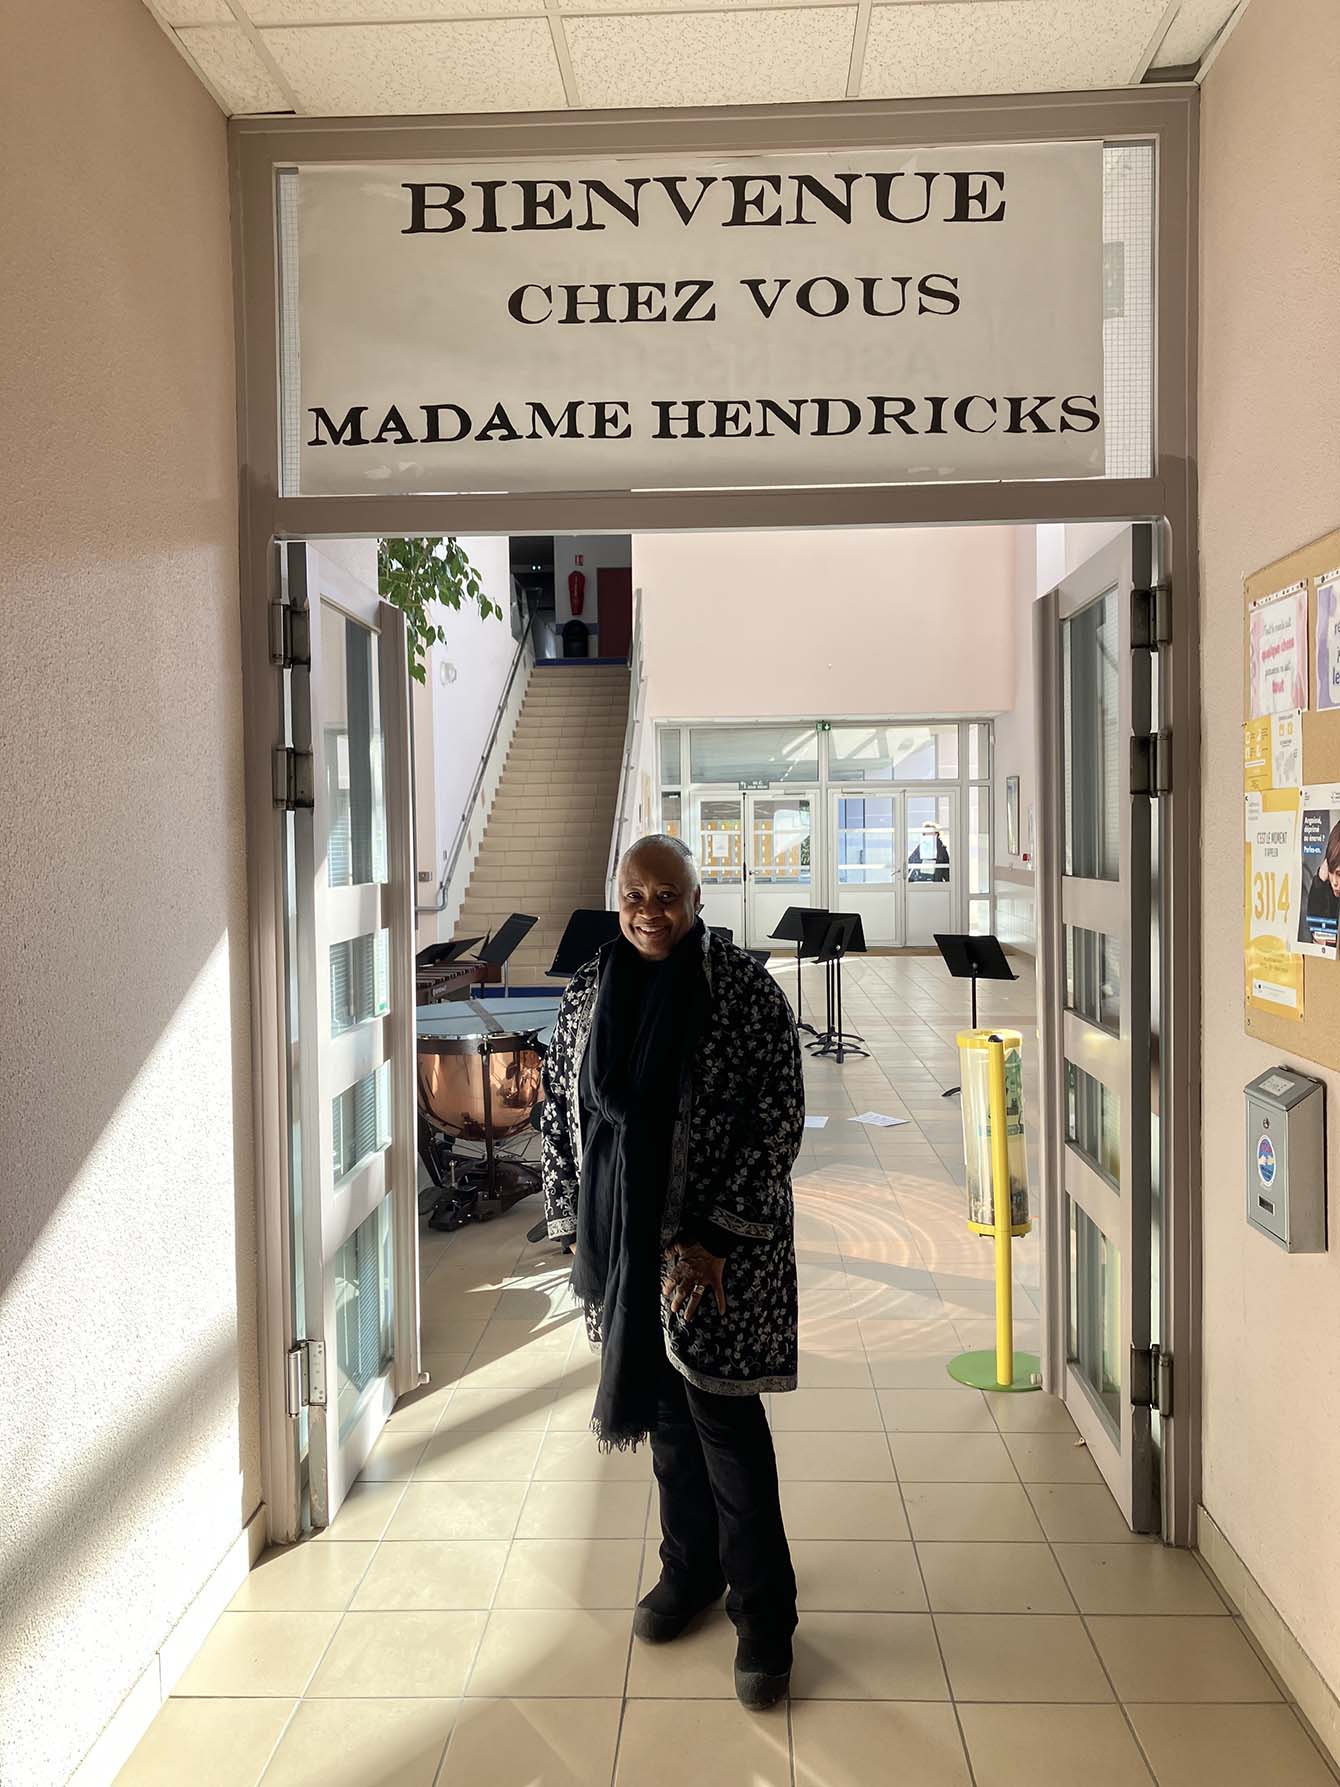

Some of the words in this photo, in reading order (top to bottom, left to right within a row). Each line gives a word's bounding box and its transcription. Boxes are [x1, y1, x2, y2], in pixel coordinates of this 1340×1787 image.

[401, 172, 1005, 234] BIENVENUE
[508, 280, 715, 325] CHEZ
[740, 274, 959, 319] VOUS
[308, 401, 631, 447] MADAME
[652, 395, 1101, 439] HENDRICKS
[1254, 872, 1290, 923] 3114
